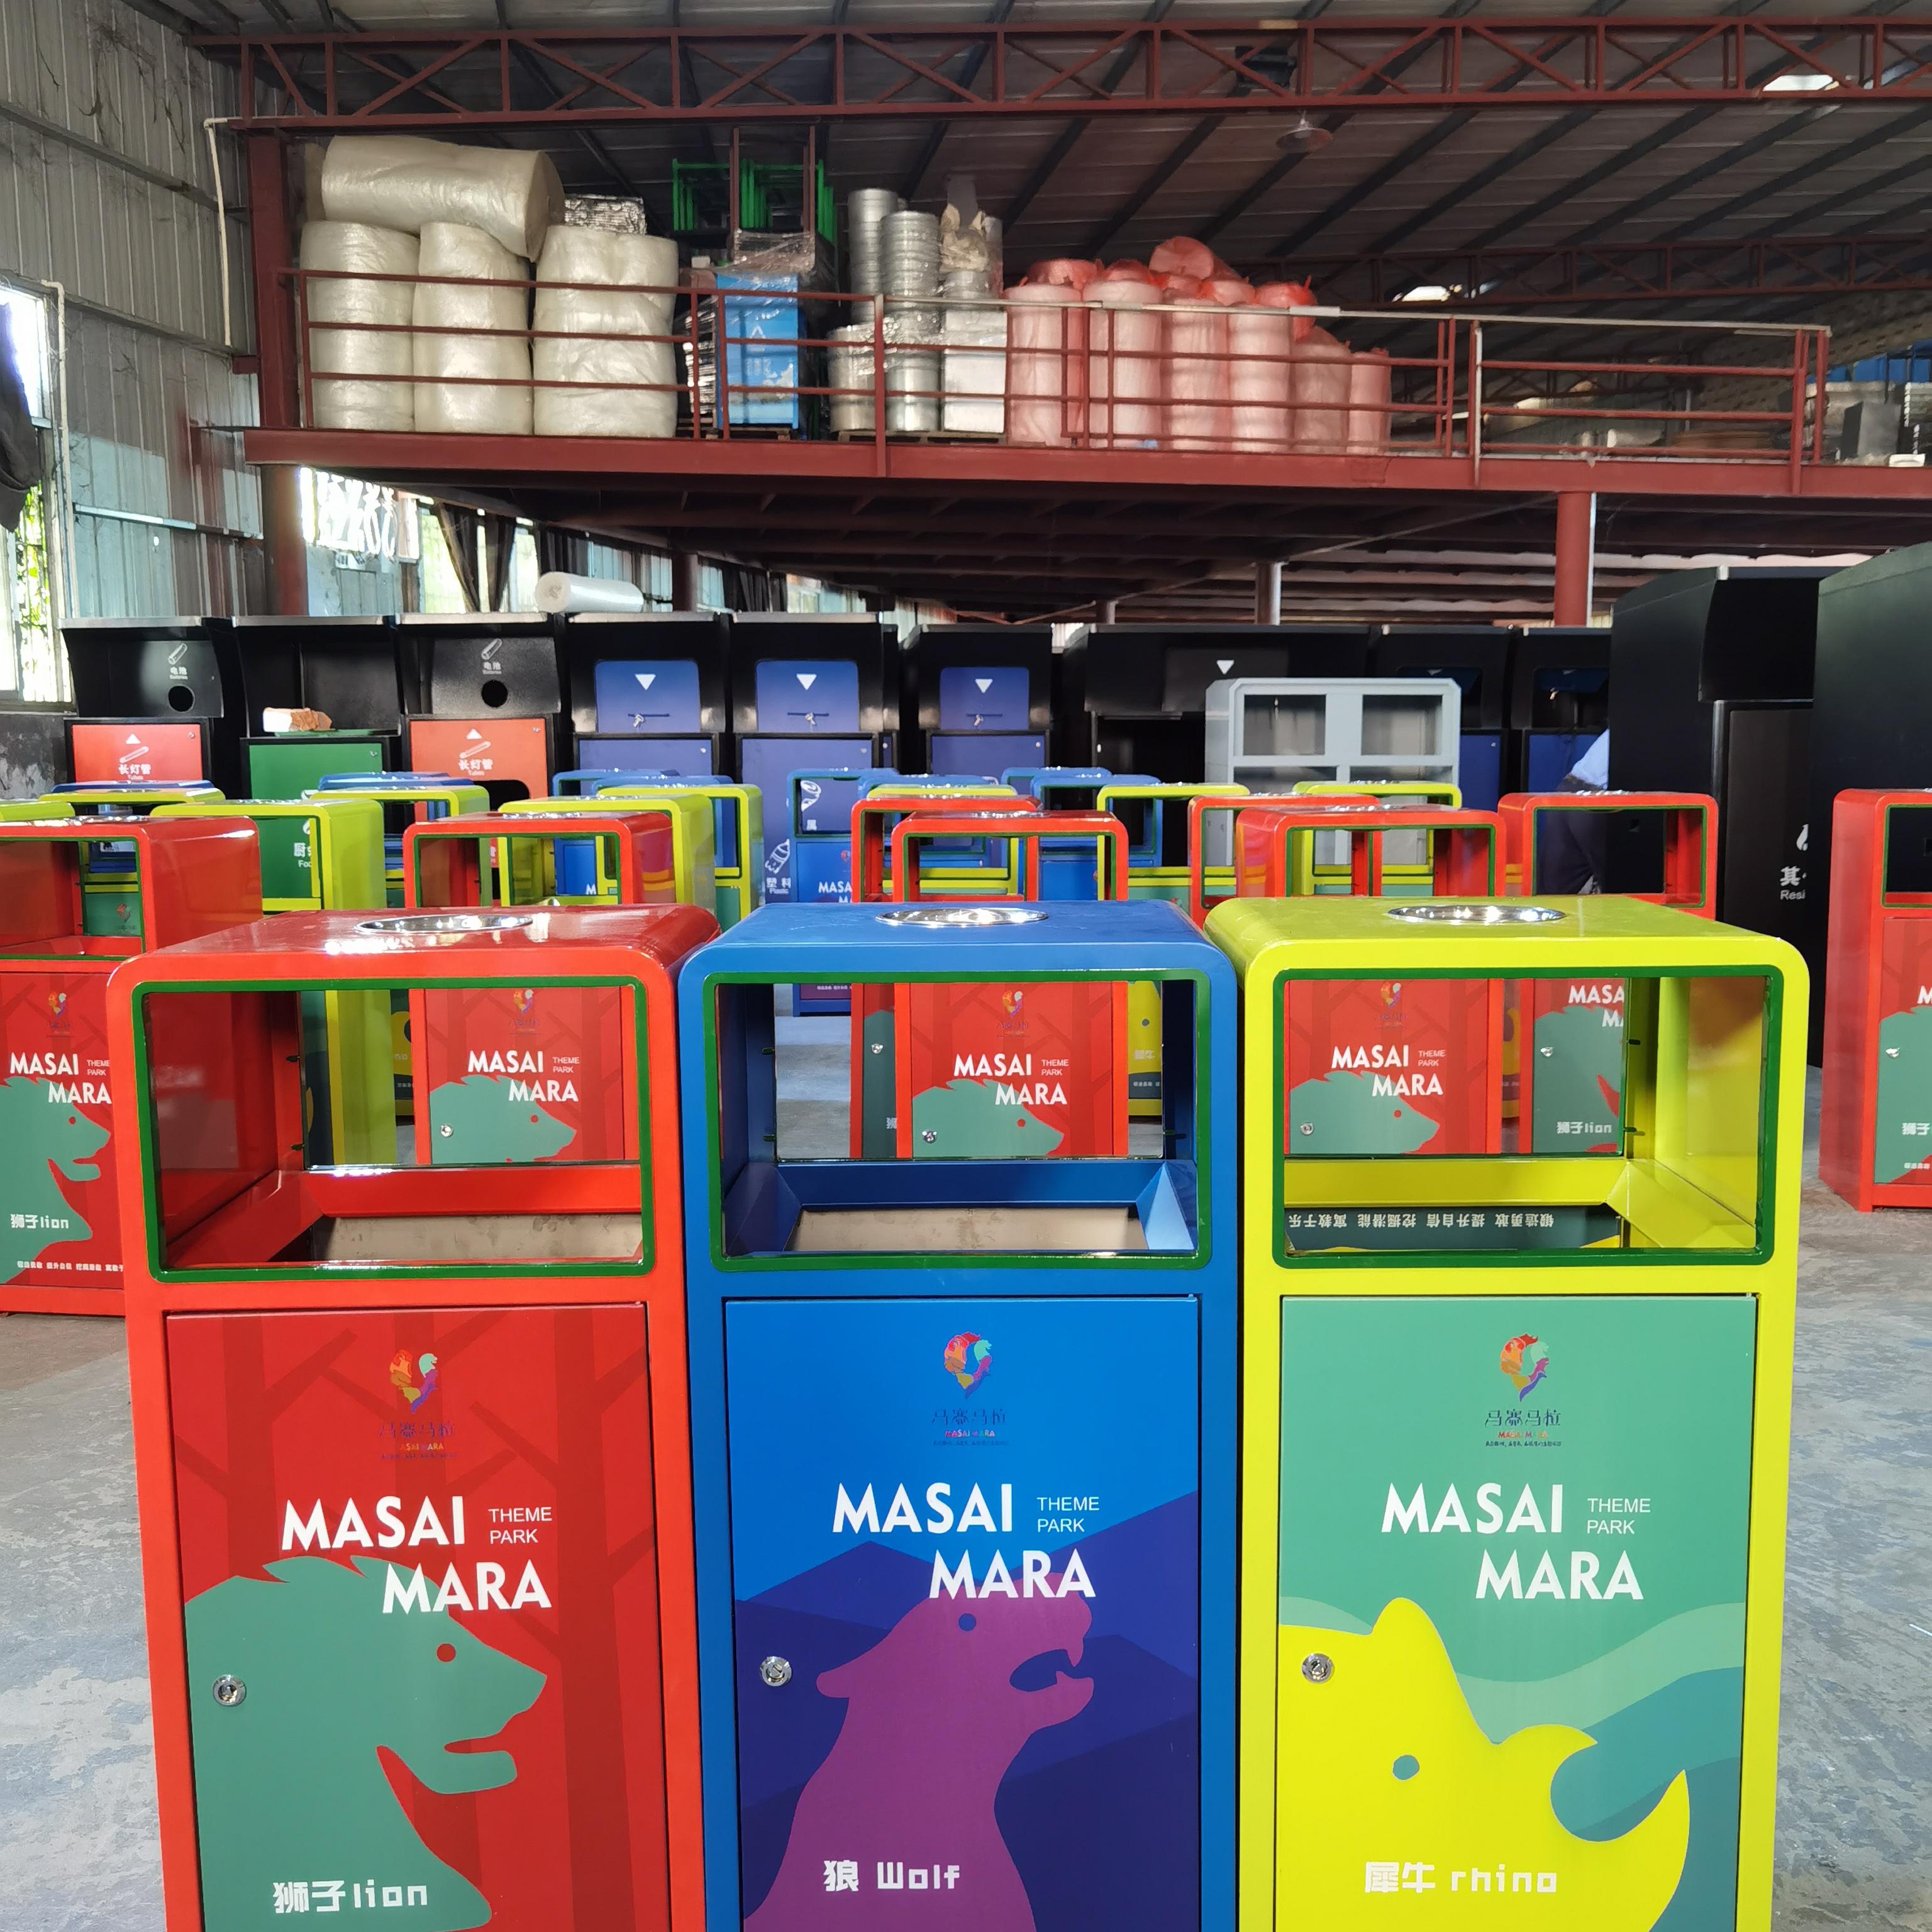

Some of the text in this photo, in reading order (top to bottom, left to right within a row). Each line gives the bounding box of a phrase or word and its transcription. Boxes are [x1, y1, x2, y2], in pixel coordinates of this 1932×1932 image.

[818, 880, 853, 893] MASA
[1780, 865, 1807, 887] 其
[1568, 984, 1625, 1004] MASA
[10, 1052, 79, 1075] MASAI
[86, 1059, 110, 1067] THEME
[467, 1050, 544, 1074] MASAI
[953, 1053, 1032, 1077] MASAI
[1041, 1058, 1069, 1067] THEME
[1331, 1045, 1409, 1069] MASAI
[1418, 1050, 1446, 1058] THEME
[48, 1081, 113, 1104] MARA
[508, 1079, 579, 1102] MARA
[995, 1082, 1067, 1106] MARA
[1372, 1074, 1443, 1097] MARA
[1357, 1213, 1417, 1229] 挖掘潜能
[1426, 1213, 1485, 1228] 提升自信
[487, 1506, 553, 1523] THEME
[832, 1482, 1013, 1534] MASAI
[1036, 1496, 1100, 1511] THEME
[1381, 1482, 1563, 1535] MASAI
[1587, 1497, 1651, 1514] THEME
[281, 1496, 465, 1551] MASAI
[1037, 1518, 1085, 1533] PARK
[1586, 1519, 1635, 1535] PARK
[489, 1528, 539, 1545] PARK
[929, 1548, 1096, 1600] MARA
[1475, 1549, 1644, 1601] MARA
[382, 1559, 552, 1615] MARA
[823, 1860, 960, 1892] 狼 Wolf
[1364, 1862, 1557, 1894] 犀牛 rhino
